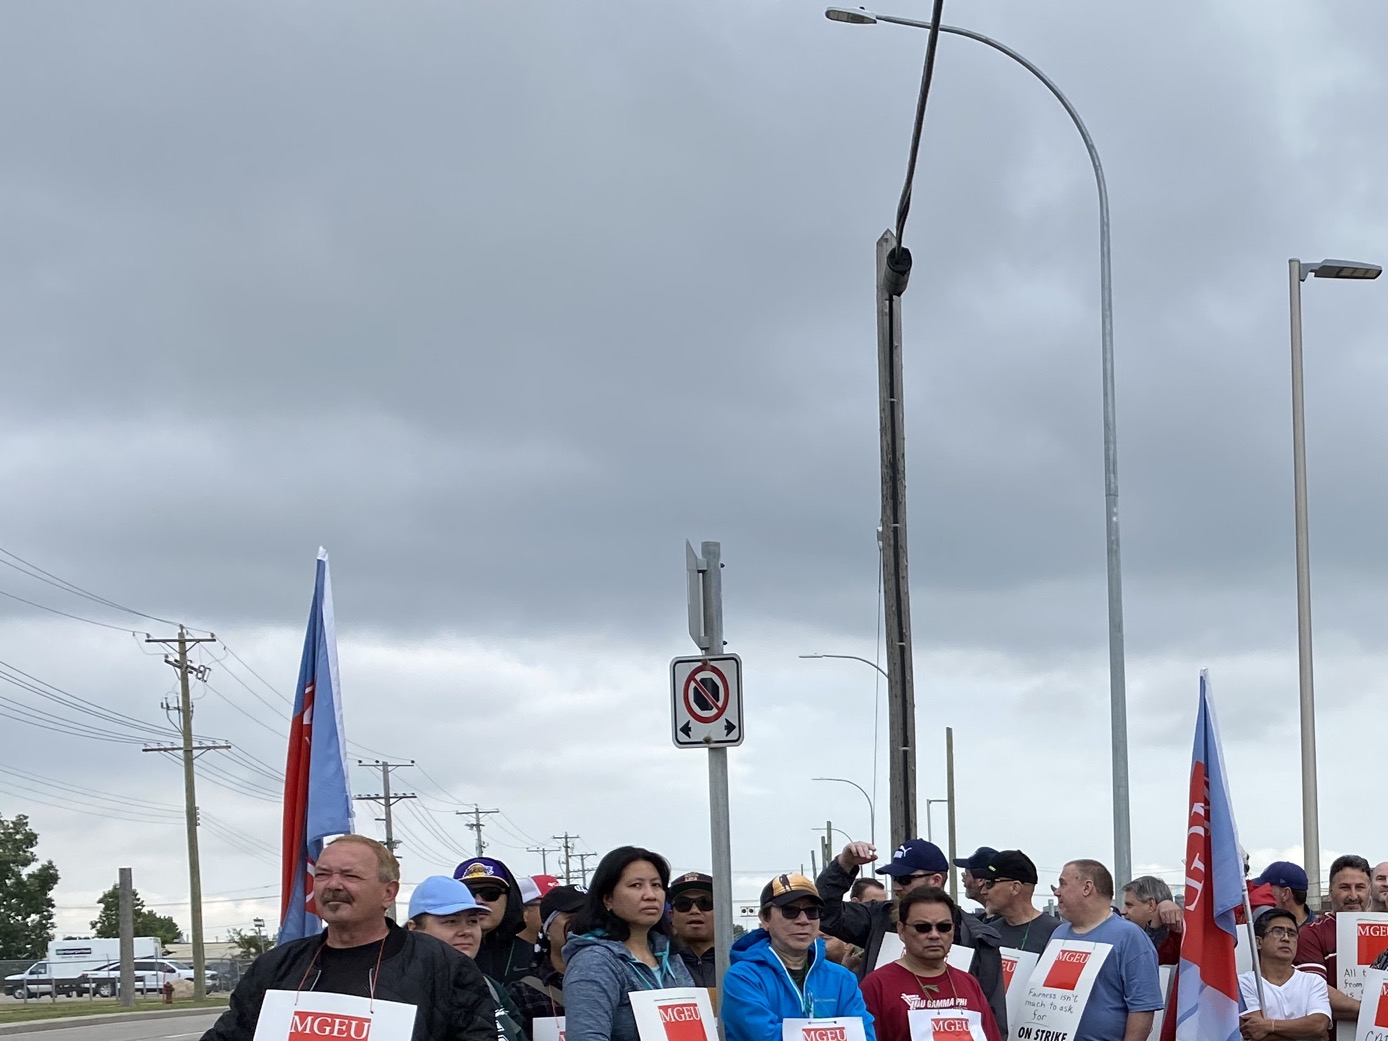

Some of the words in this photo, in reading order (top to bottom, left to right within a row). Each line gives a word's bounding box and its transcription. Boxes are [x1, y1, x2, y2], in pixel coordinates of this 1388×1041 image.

[1057, 951, 1091, 964] MGEU
[1001, 959, 1017, 972] EU
[1344, 968, 1356, 977] All
[1344, 979, 1362, 988] from
[1028, 988, 1056, 999] Fairness
[1060, 994, 1078, 1003] isn't
[927, 998, 954, 1008] GAMMA
[956, 998, 968, 1007] PHI
[1025, 1000, 1045, 1008] much
[1050, 1002, 1057, 1010] to
[1060, 1004, 1073, 1014] ask
[659, 1006, 700, 1023] MGEU
[1032, 1009, 1047, 1020] for
[290, 1015, 371, 1040] MGEU
[931, 1019, 970, 1032] MGEU
[1018, 1026, 1032, 1040] ON
